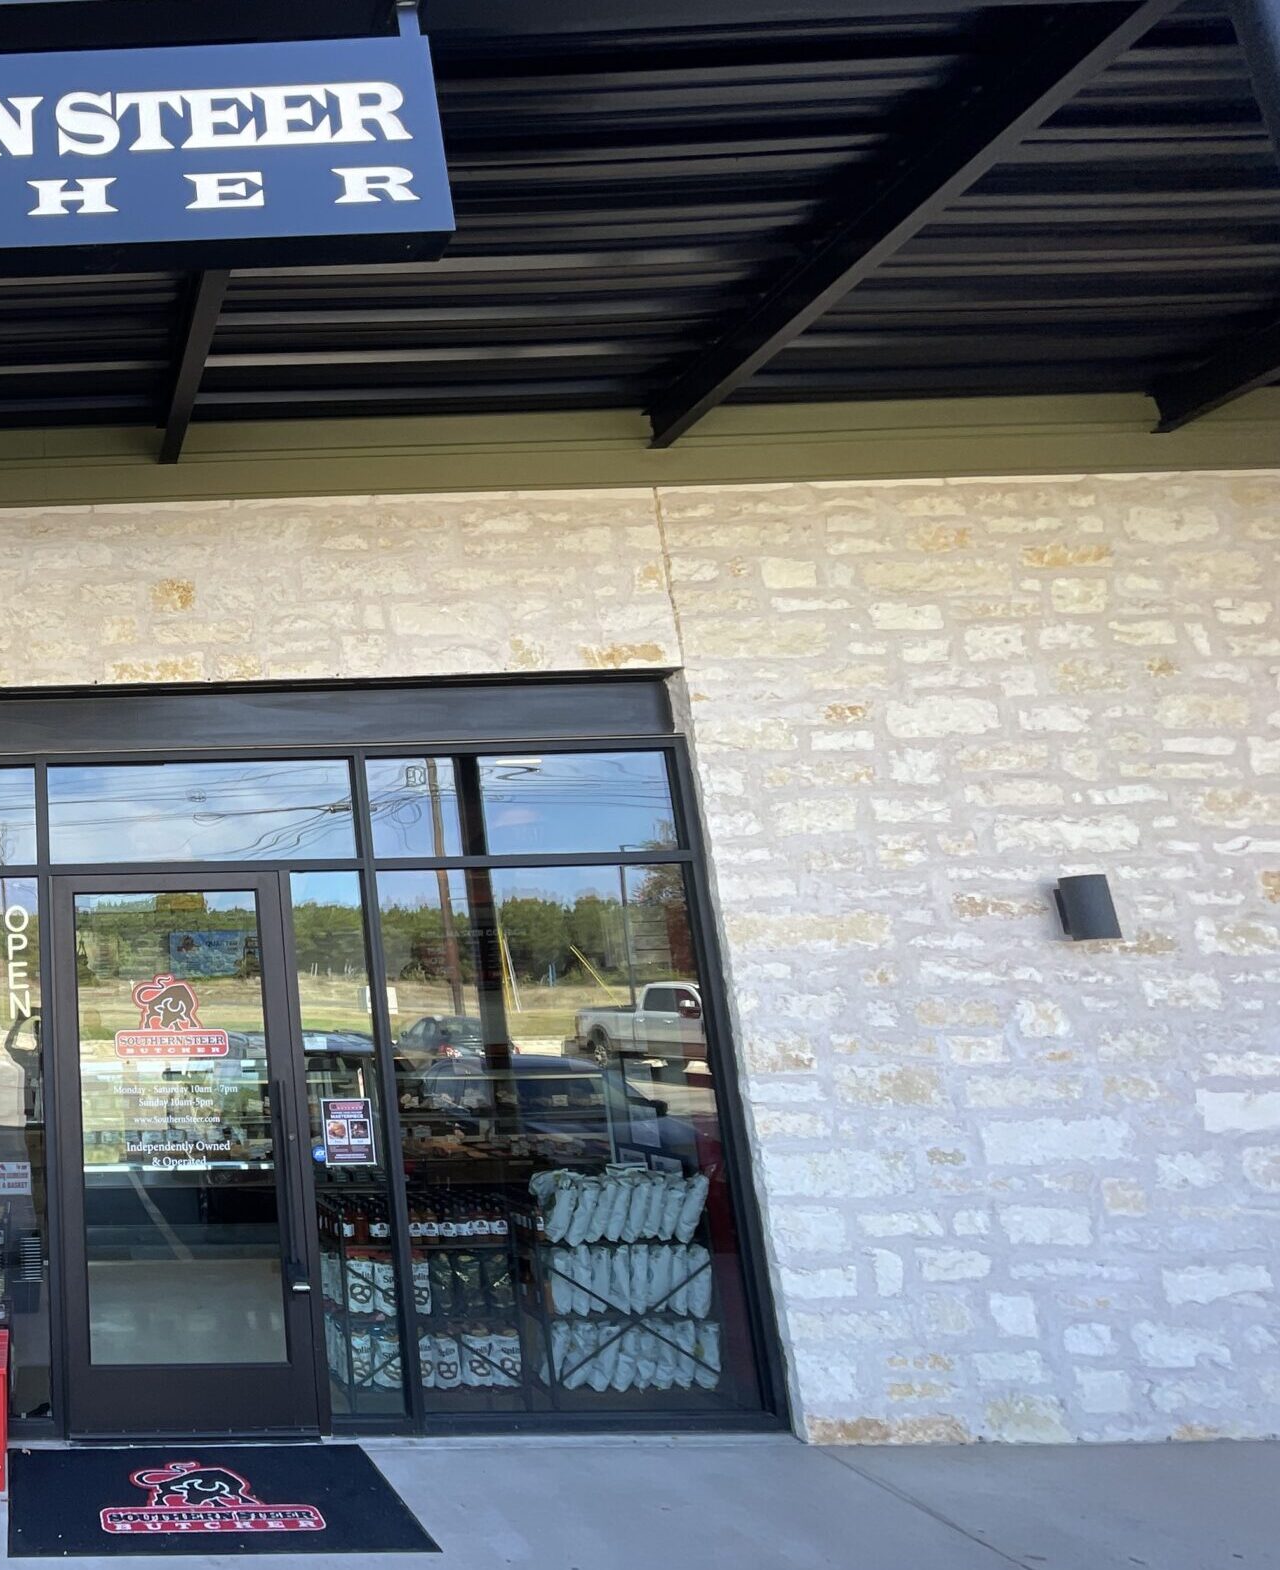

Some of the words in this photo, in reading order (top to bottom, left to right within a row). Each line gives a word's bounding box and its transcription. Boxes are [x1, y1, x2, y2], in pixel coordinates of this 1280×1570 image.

[55, 82, 413, 156] STEER
[4, 905, 32, 1020] OPEN
[119, 1035, 183, 1046] SOUTHERN
[185, 1035, 225, 1046] STEER
[113, 1085, 145, 1095] Monday
[153, 1085, 188, 1095] Saturday
[190, 1084, 212, 1093] 10am
[219, 1084, 238, 1095] 7pm
[139, 1098, 168, 1108] Sunday
[134, 1114, 221, 1123] www.SouthernSteer.com
[126, 1141, 194, 1154] Independently
[195, 1140, 231, 1151] Owned
[152, 1157, 161, 1167] &
[162, 1155, 207, 1168] Operated
[109, 1512, 235, 1522] SOUTHERN
[237, 1511, 316, 1521] STEER
[115, 1521, 317, 1530] BUTCHER
